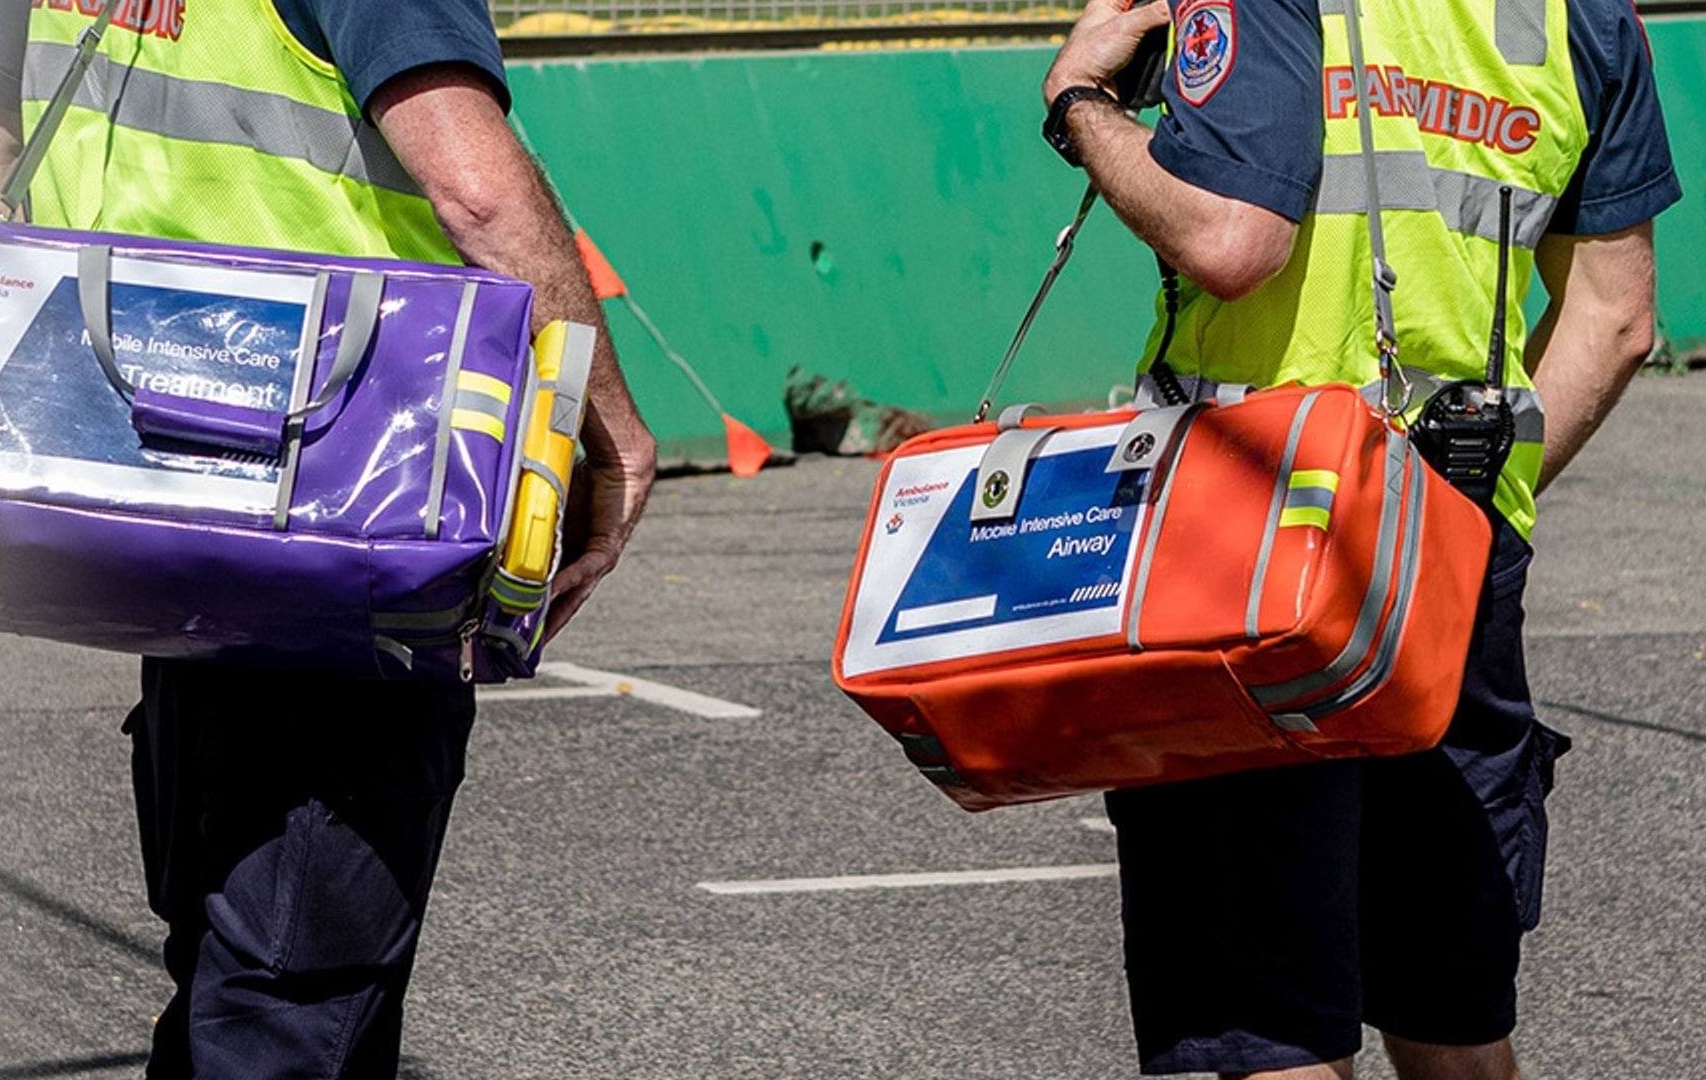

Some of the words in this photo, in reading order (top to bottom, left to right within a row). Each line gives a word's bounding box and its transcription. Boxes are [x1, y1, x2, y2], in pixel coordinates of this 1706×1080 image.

[80, 328, 143, 353] Mbile
[147, 336, 230, 362] Intensive
[233, 347, 282, 369] Care
[121, 362, 277, 408] Treatment
[969, 525, 1017, 543] Mobile
[1019, 510, 1084, 535] Intensive
[1085, 505, 1123, 524] Care
[1046, 533, 1117, 560] Airway
